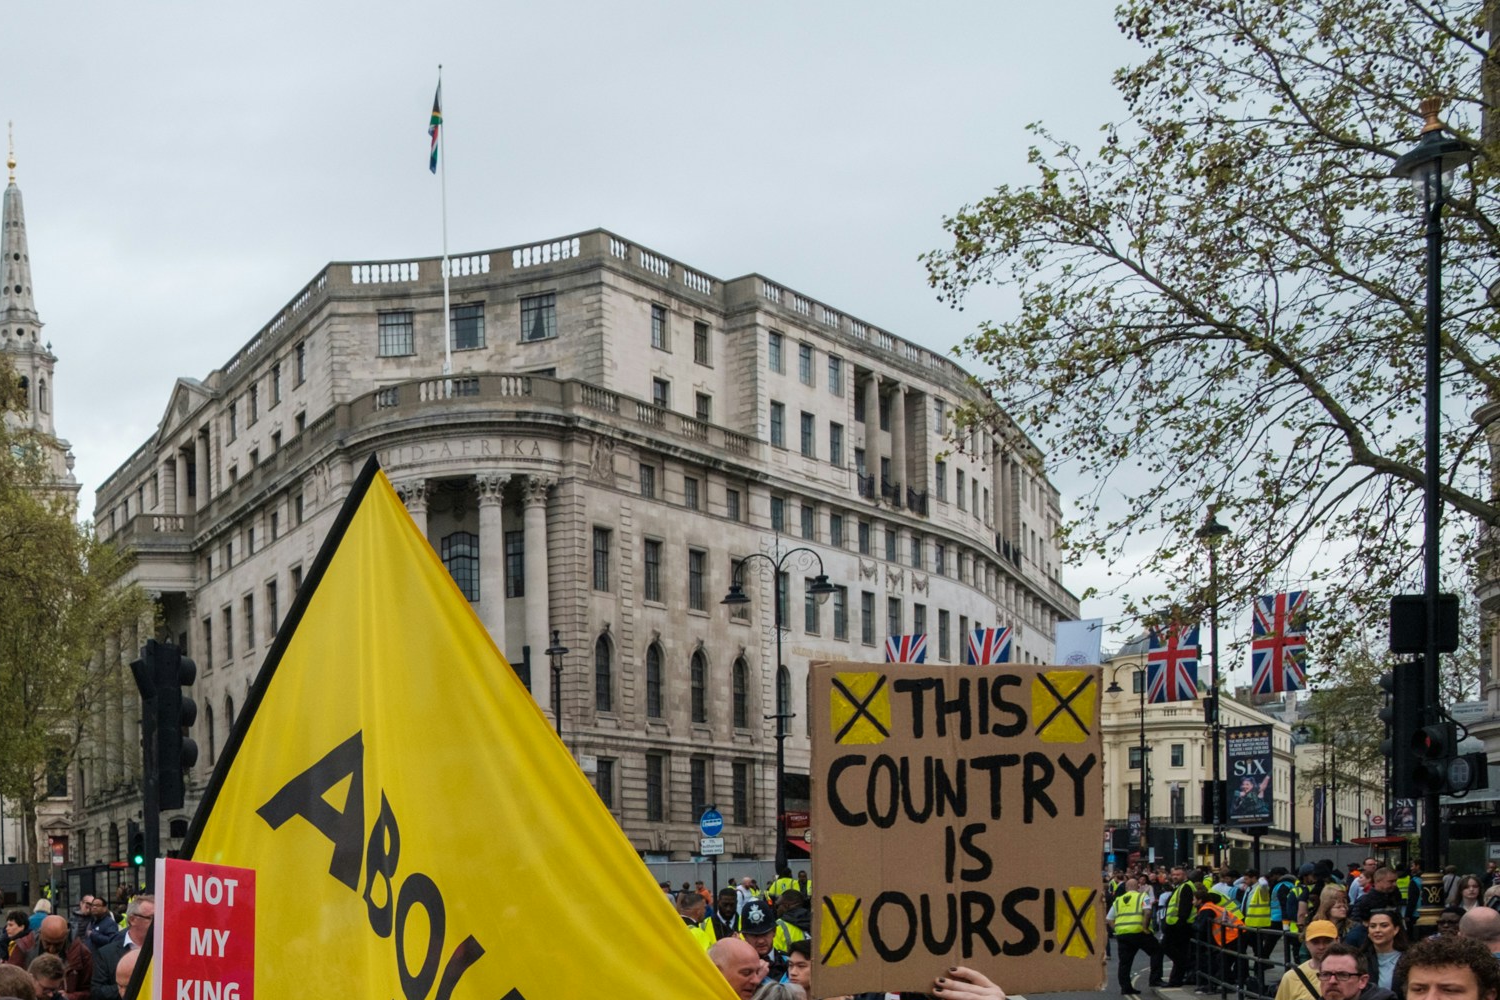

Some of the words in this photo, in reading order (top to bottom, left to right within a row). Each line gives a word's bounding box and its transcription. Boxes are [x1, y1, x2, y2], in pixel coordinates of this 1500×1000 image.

[894, 675, 1028, 740] THIS
[827, 752, 1097, 829] COUNTRY
[1234, 759, 1266, 776] SIX
[945, 823, 993, 884] IS
[184, 873, 238, 907] NOT
[190, 927, 230, 958] MY
[868, 887, 1055, 962] OURS!
